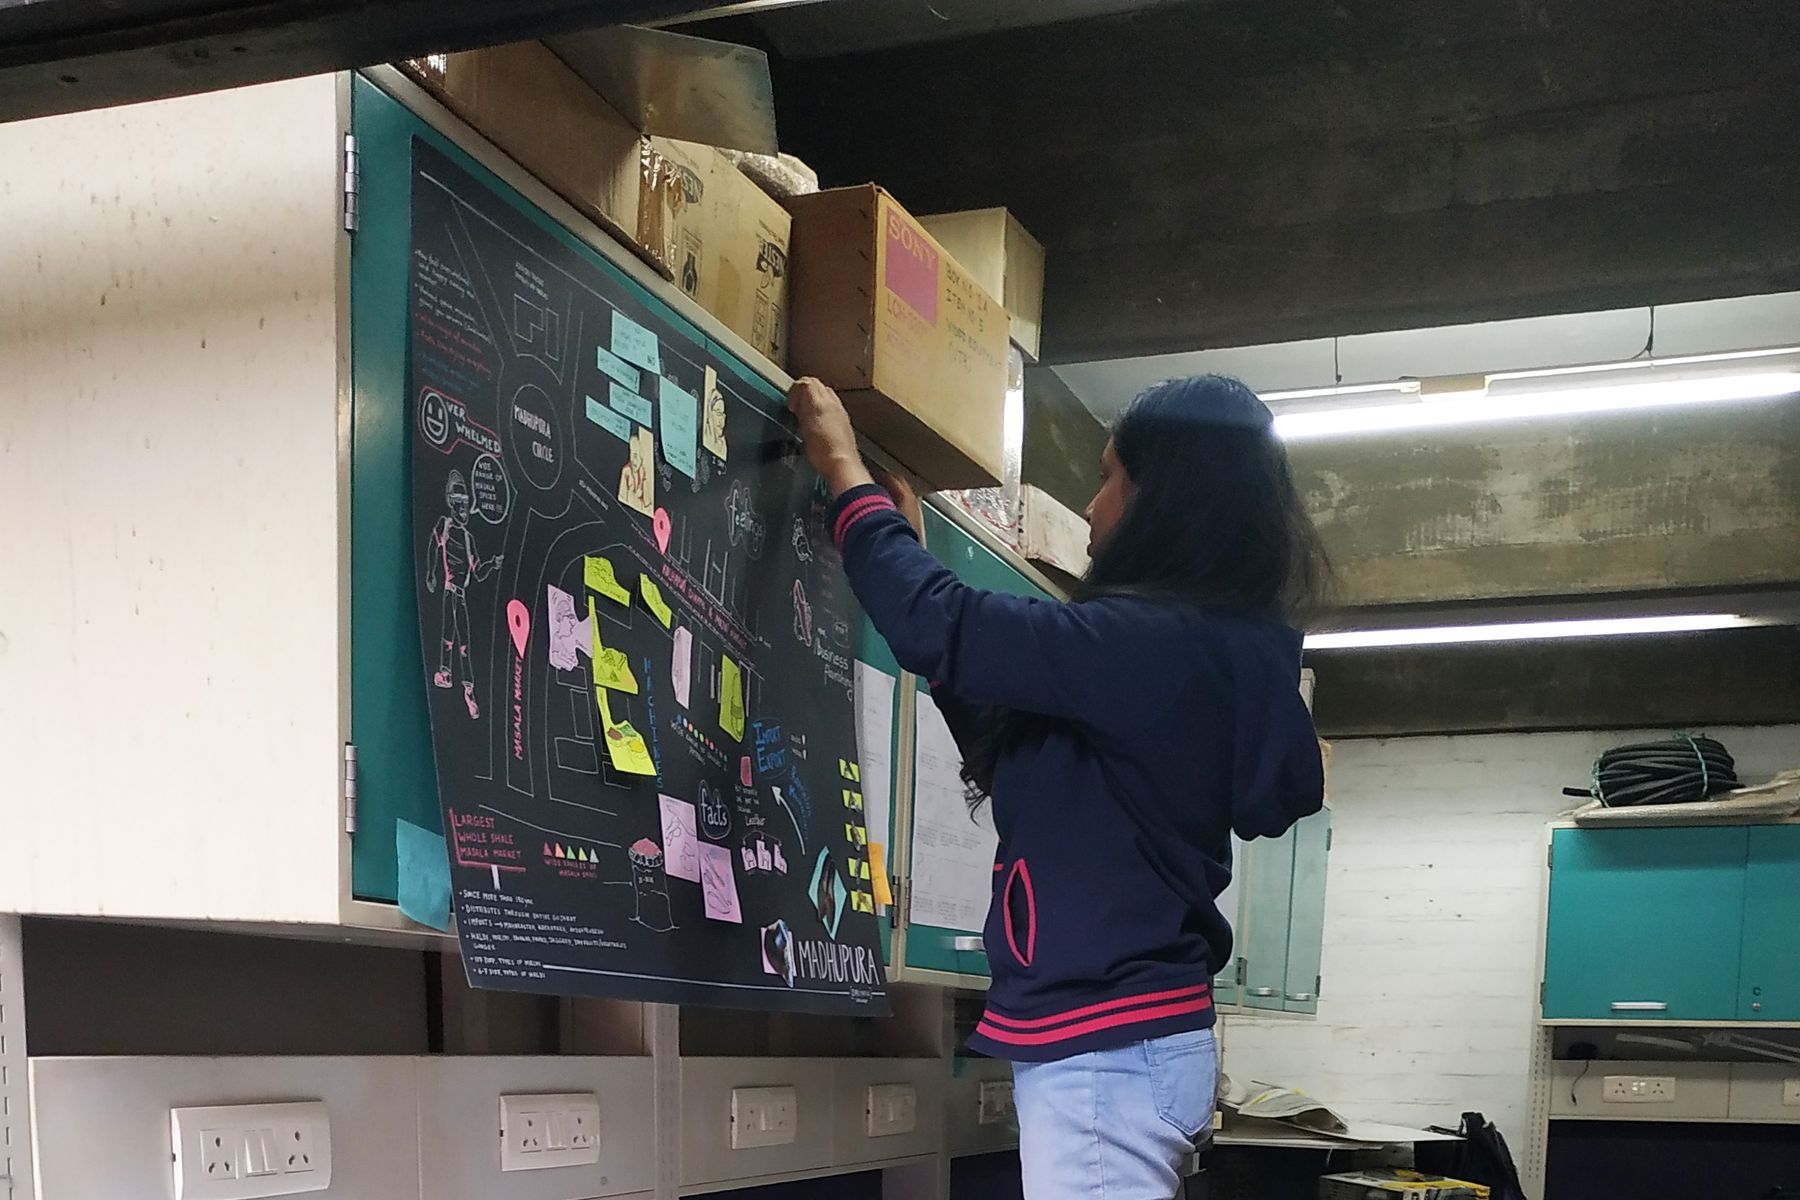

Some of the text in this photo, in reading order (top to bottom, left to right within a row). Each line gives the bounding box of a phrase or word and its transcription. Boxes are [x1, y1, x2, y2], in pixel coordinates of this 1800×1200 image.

[889, 215, 936, 269] SONY
[455, 422, 501, 453] WHELMED
[531, 441, 554, 463] CIRCLE
[513, 655, 524, 761] MASALA MARKET
[701, 787, 728, 826] facts
[455, 815, 495, 828] LARGEST
[458, 832, 487, 843] WHOLE
[460, 847, 521, 859] MASALA MARKET
[463, 889, 480, 900] SINCE
[483, 893, 498, 902] MORE
[798, 940, 880, 985] MADHUPURA
